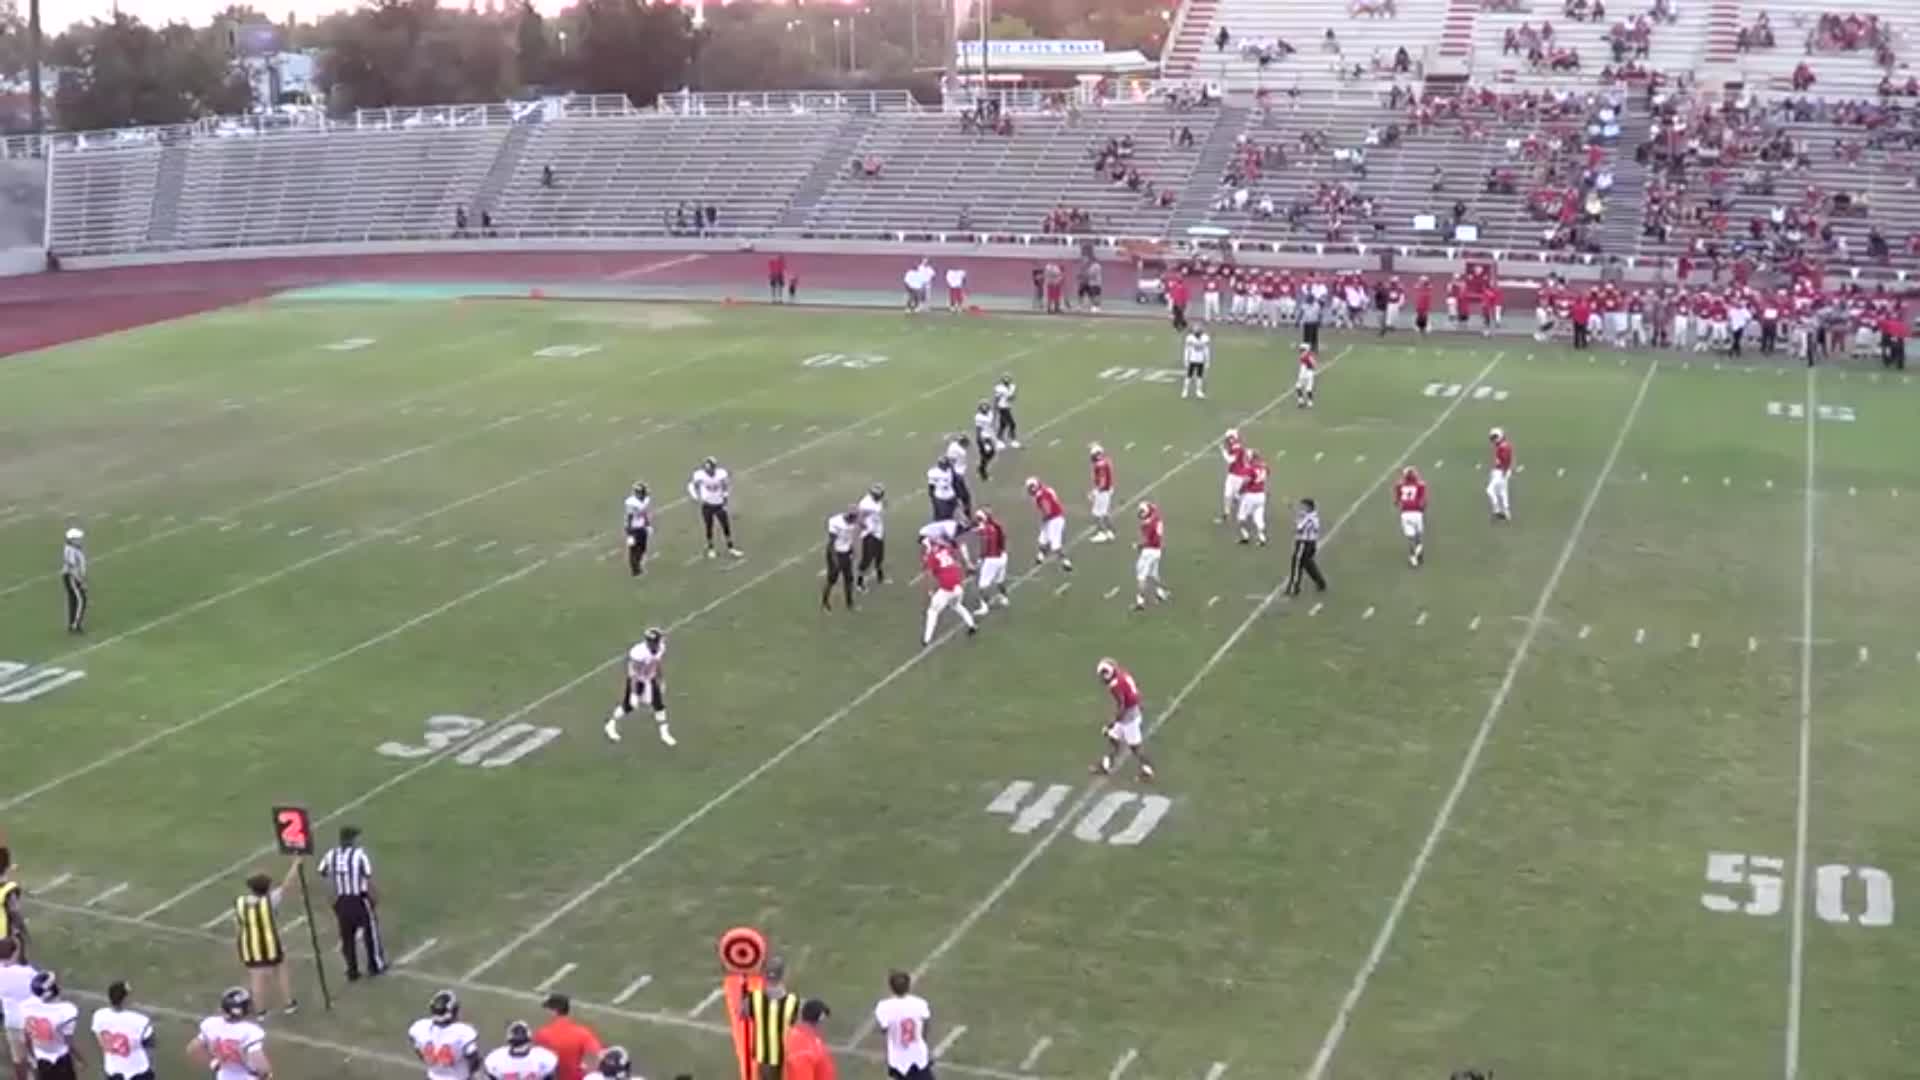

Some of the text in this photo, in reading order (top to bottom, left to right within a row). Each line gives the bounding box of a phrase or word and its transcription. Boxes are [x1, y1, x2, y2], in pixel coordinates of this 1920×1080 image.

[376, 715, 562, 767] 30
[278, 811, 306, 848] 2
[986, 780, 1171, 845] 40
[1702, 854, 1894, 926] 50
